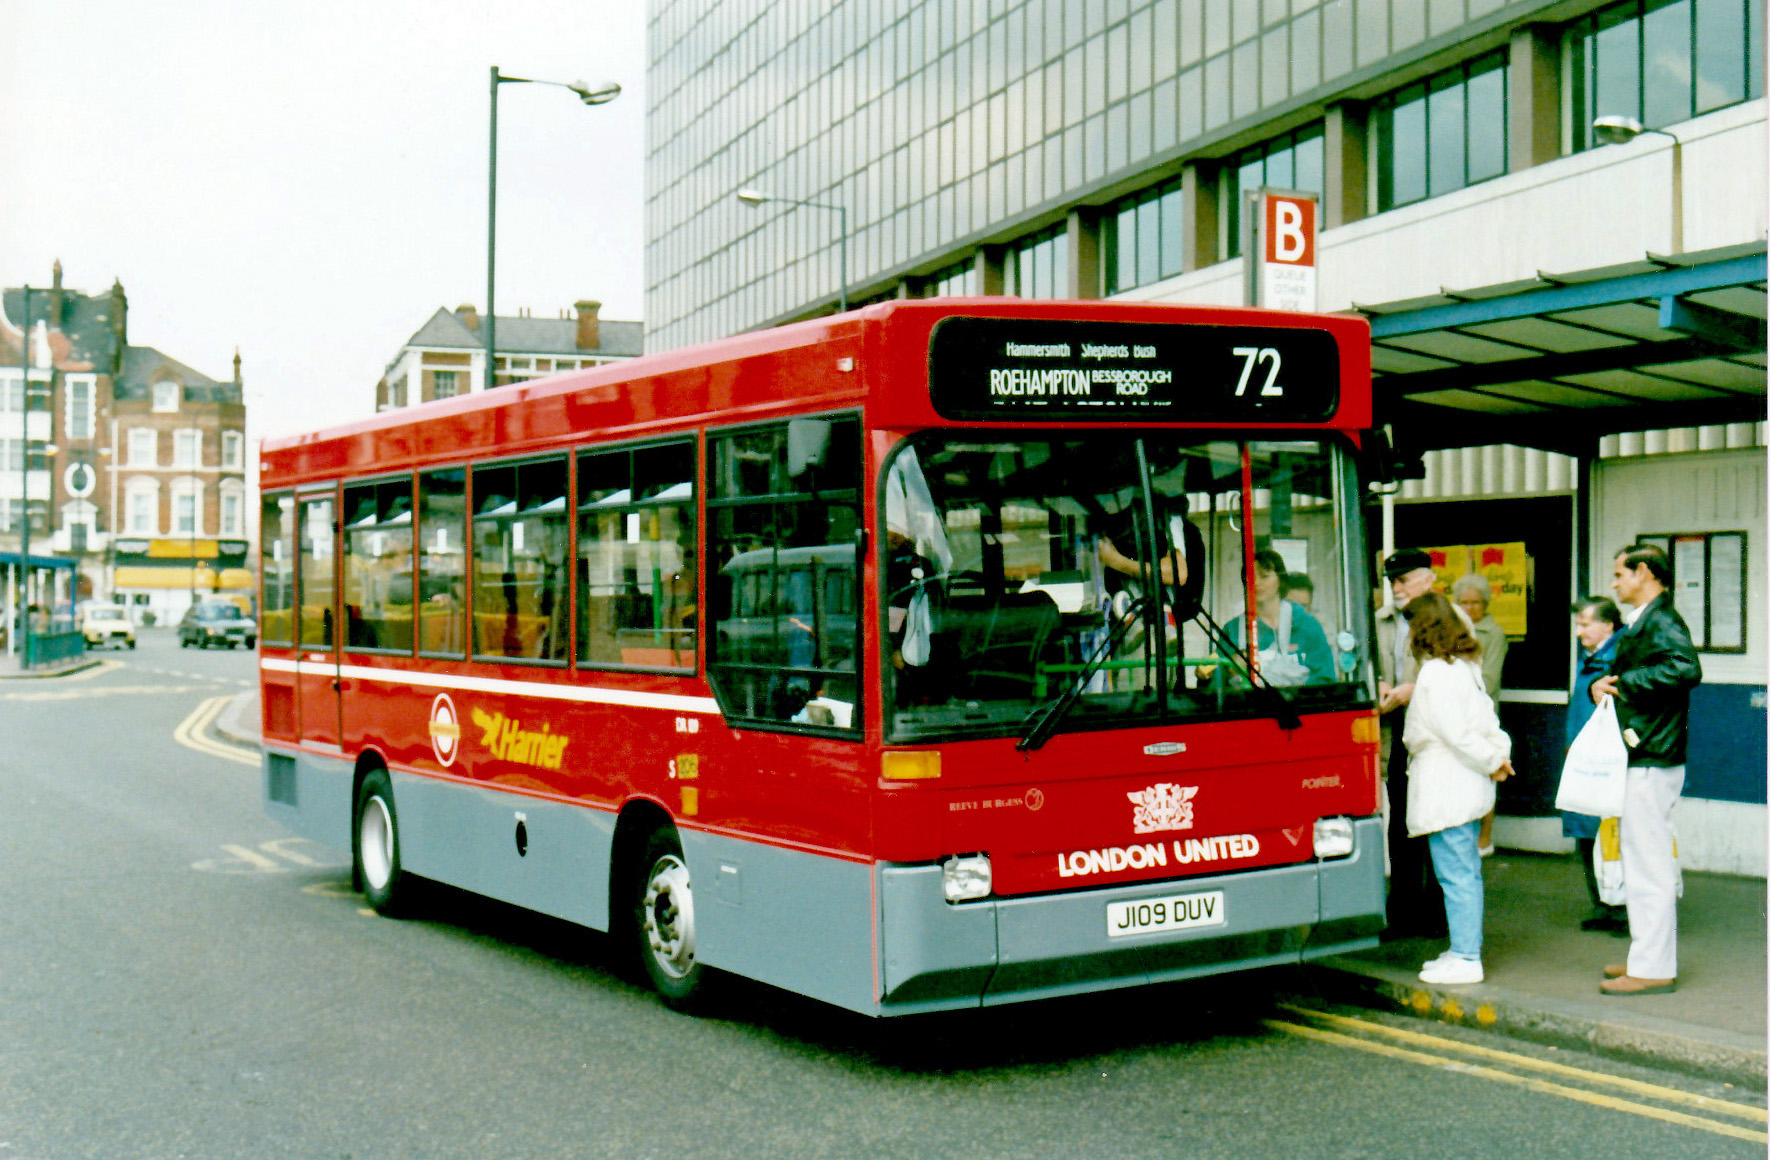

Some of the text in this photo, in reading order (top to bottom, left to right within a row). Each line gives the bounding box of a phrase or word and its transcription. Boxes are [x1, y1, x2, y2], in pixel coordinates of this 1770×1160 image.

[1275, 200, 1306, 262] B
[1006, 342, 1070, 358] Hammersmith
[1080, 343, 1130, 361] Shepherds
[989, 369, 1091, 396] ROEHAMPTON
[1092, 369, 1172, 384] BESSBOROUGH
[1232, 347, 1284, 396] 72
[1116, 383, 1148, 396] ROAD
[498, 718, 569, 769] Harrier
[668, 760, 677, 778] S
[949, 801, 978, 812] REEVE
[1058, 833, 1260, 878] LONDON UNITED
[1117, 896, 1217, 929] J109 DUV
